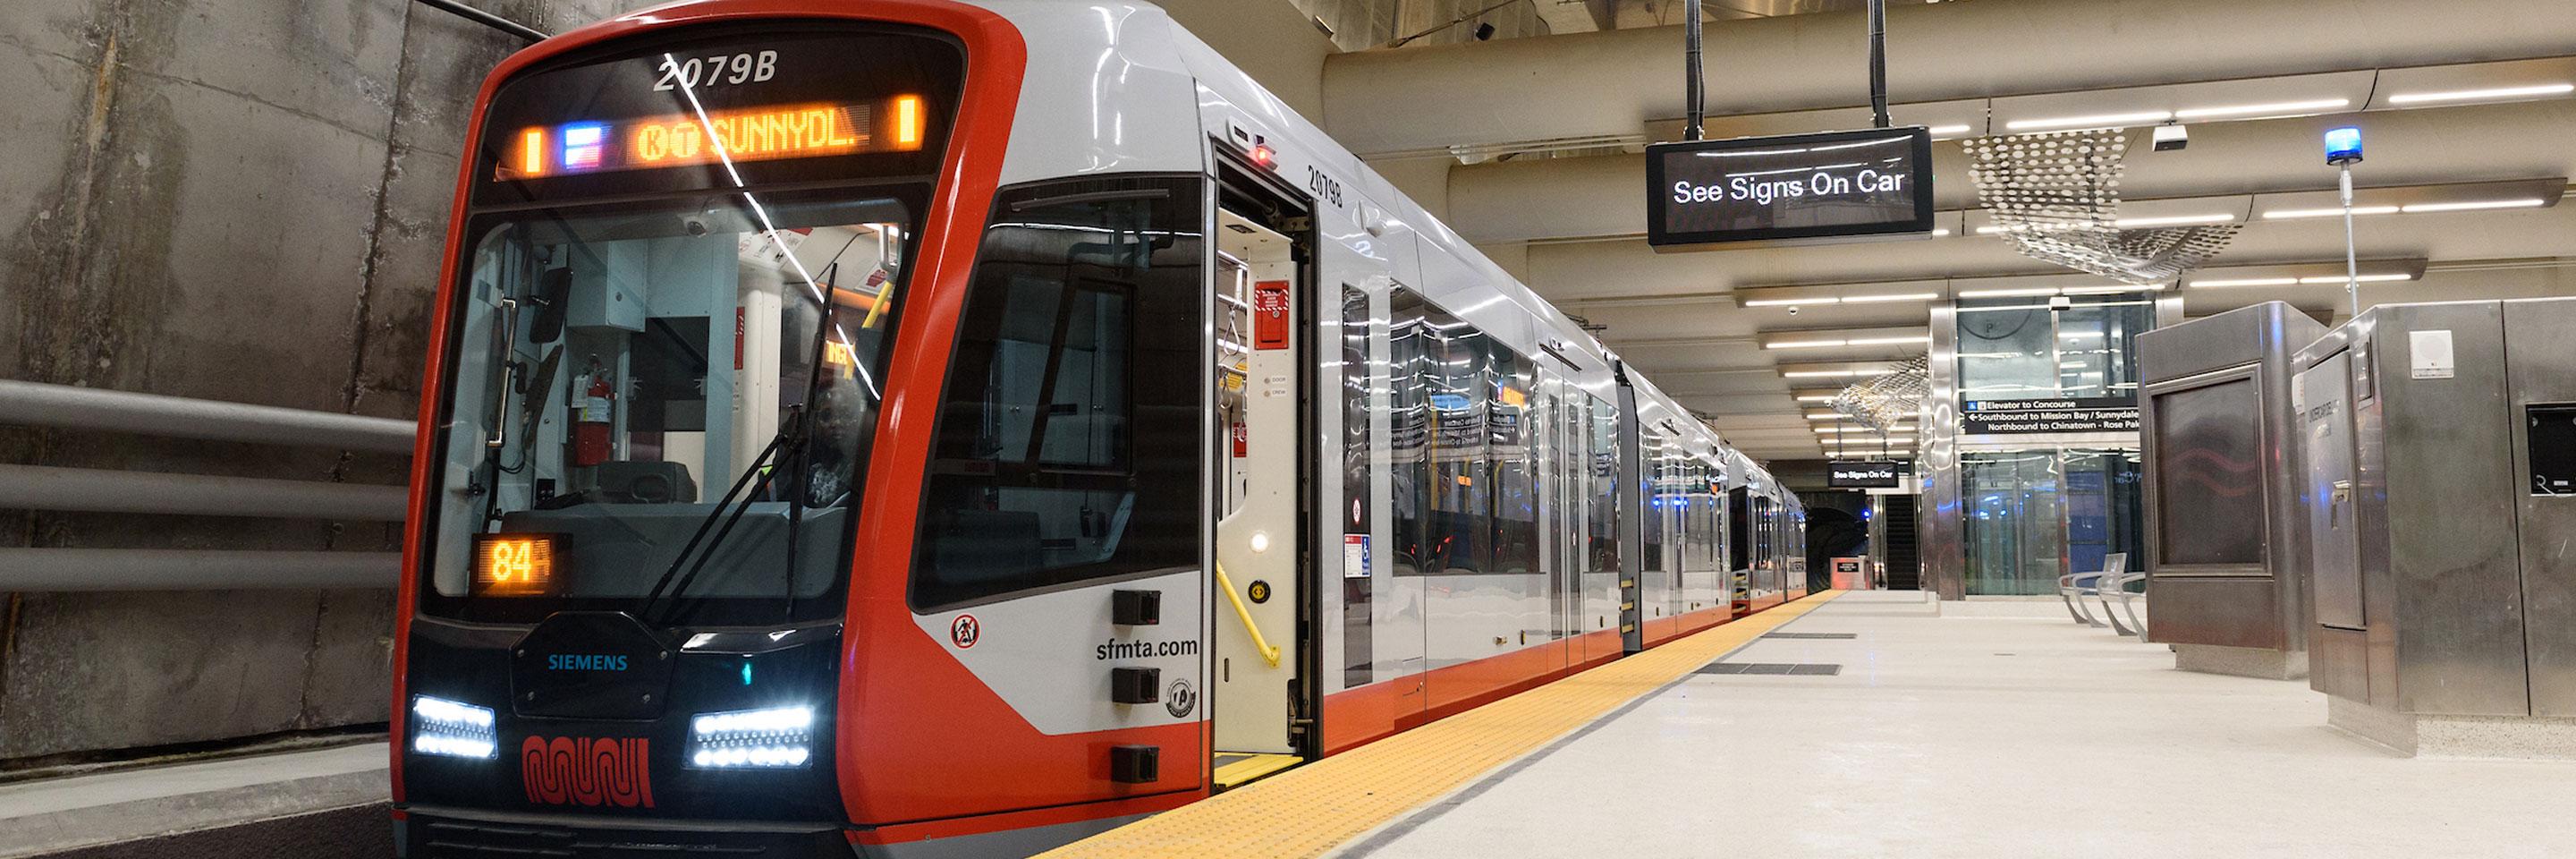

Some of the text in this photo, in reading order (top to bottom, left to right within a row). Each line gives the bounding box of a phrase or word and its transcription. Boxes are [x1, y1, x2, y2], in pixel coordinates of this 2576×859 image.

[653, 50, 778, 91] 2079B
[1308, 165, 1343, 208] 2079B
[1674, 169, 1906, 206] See Signs On Car
[1978, 412, 2029, 421] Southbound
[2029, 412, 2039, 421] to
[2040, 412, 2072, 421] Mission
[2073, 411, 2089, 421] Bay
[2095, 410, 2140, 420] Sunnydale
[1987, 400, 2076, 410] Elevator to Concourse
[1987, 422, 2038, 431] Northbound
[2050, 421, 2097, 430] Chinatown
[2103, 421, 2123, 429] Rose
[2124, 420, 2140, 429] Pak
[1834, 470, 1894, 481] See Signs On Car
[492, 542, 532, 582] 84
[1097, 637, 1198, 660] sfmta.com
[547, 654, 629, 671] SIEMENS
[521, 735, 656, 809] MUNI
